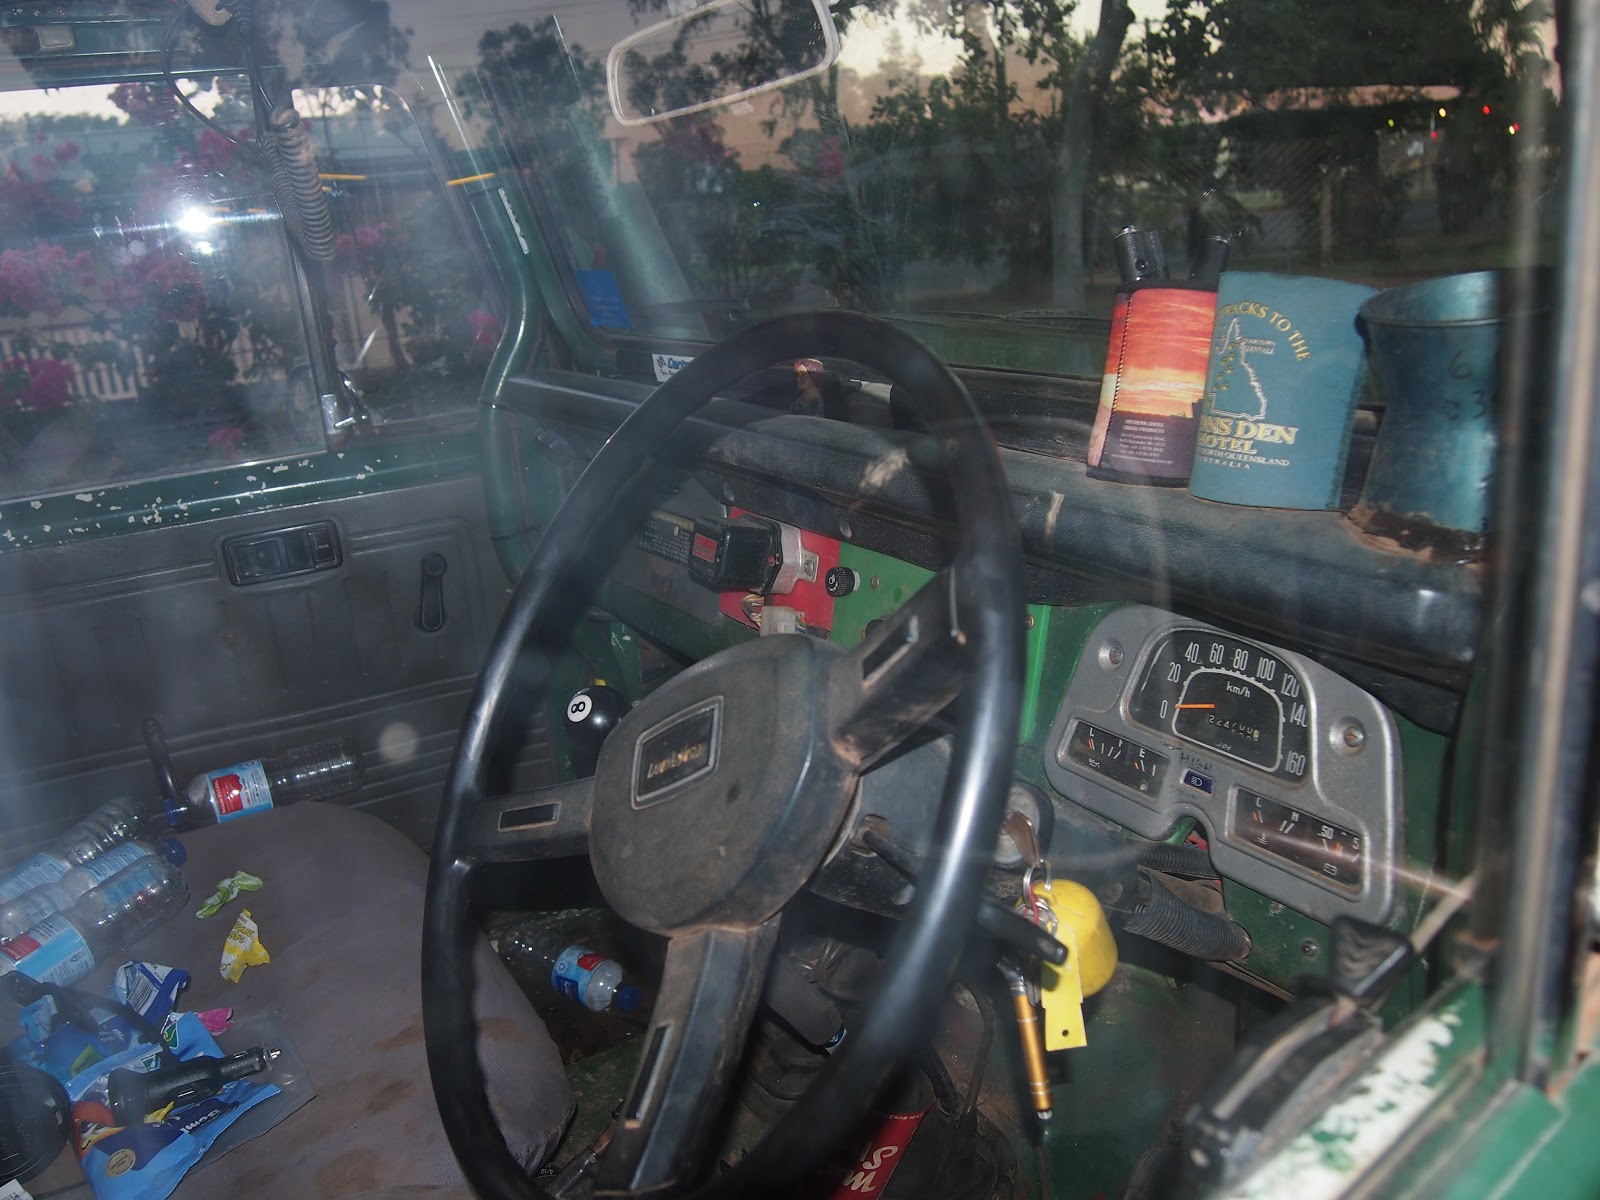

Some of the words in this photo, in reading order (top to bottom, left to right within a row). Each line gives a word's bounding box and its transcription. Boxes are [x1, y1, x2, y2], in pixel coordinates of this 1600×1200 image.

[1269, 311, 1291, 332] TO
[1288, 330, 1311, 361] THE
[1199, 432, 1257, 455] HOTEL
[1234, 420, 1299, 445] DEN
[1199, 455, 1250, 470] USTRALIA
[1225, 451, 1290, 467] QUEENSLAND
[1184, 642, 1200, 664] 40
[1209, 643, 1224, 665] 60
[1232, 648, 1248, 671] 80
[1167, 662, 1181, 683] 20
[1256, 656, 1276, 681] 100
[1226, 681, 1251, 698] km/h
[1280, 673, 1299, 698] 120
[571, 701, 586, 714] 8
[1159, 700, 1168, 719] 0
[1139, 748, 1145, 758] E
[1285, 751, 1306, 776] 160
